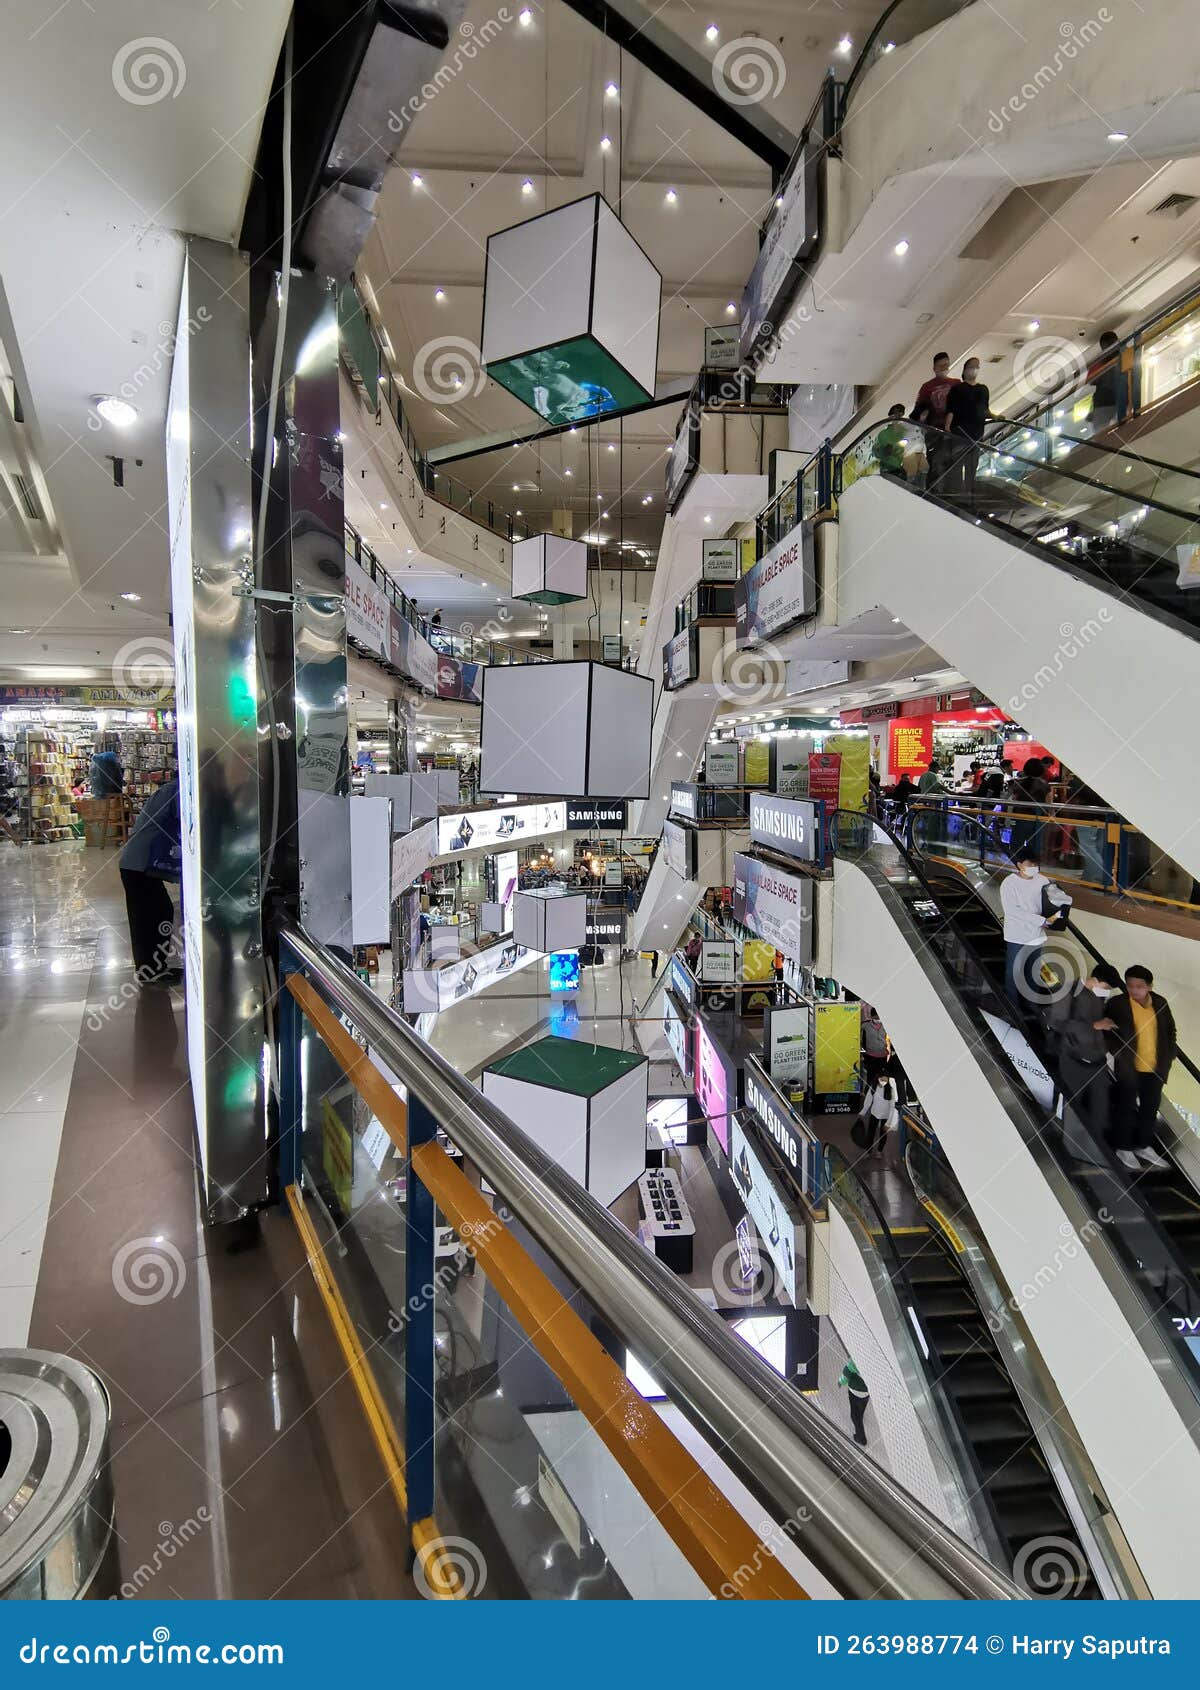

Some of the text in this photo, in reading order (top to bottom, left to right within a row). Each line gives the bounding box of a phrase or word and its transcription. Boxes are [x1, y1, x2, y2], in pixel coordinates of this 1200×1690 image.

[778, 543, 798, 573] SPACE
[363, 594, 384, 629] SPACE
[90, 689, 160, 701] AMAZON
[568, 810, 623, 821] SAMSUNG
[754, 806, 804, 843] SAMSUNG
[777, 883, 798, 905] SPACE
[586, 924, 621, 935] MSUNG
[774, 1048, 806, 1059] GO GREEN
[789, 1055, 806, 1063] TREES
[748, 1078, 798, 1168] SAMSUNG
